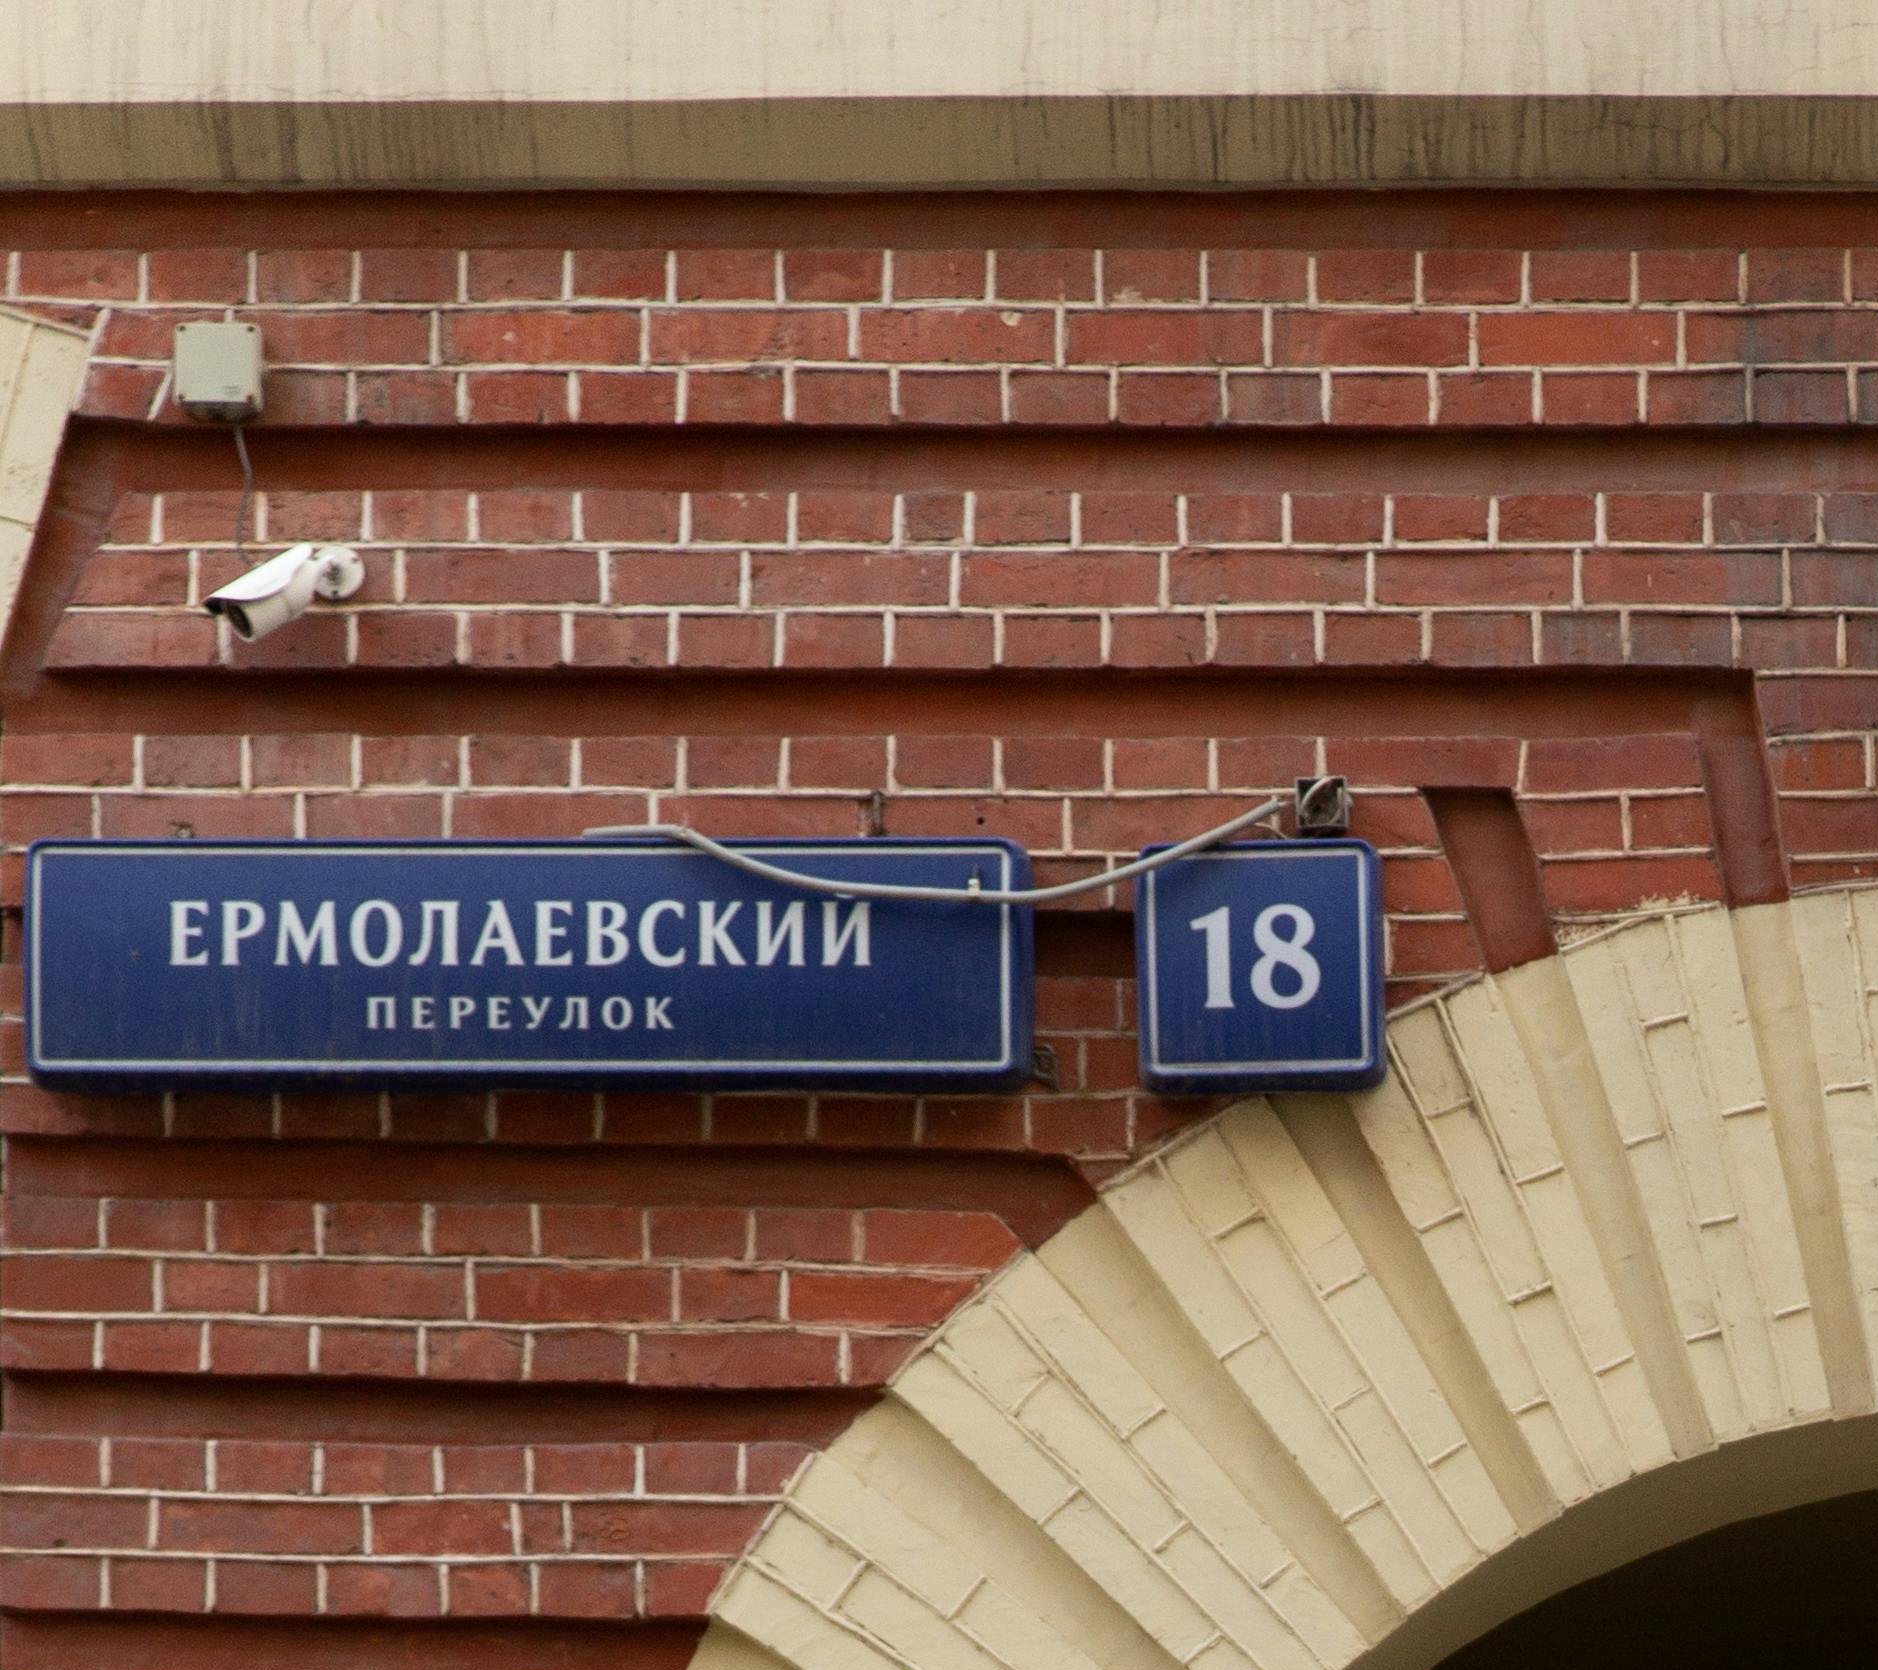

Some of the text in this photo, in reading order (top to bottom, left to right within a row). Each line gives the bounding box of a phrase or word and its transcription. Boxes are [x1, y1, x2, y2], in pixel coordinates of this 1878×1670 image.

[168, 893, 872, 967] ЕРМОЛАЕВСКИЙ
[1189, 902, 1322, 1011] 18
[366, 996, 675, 1031] ПЕРЕУЛОК
